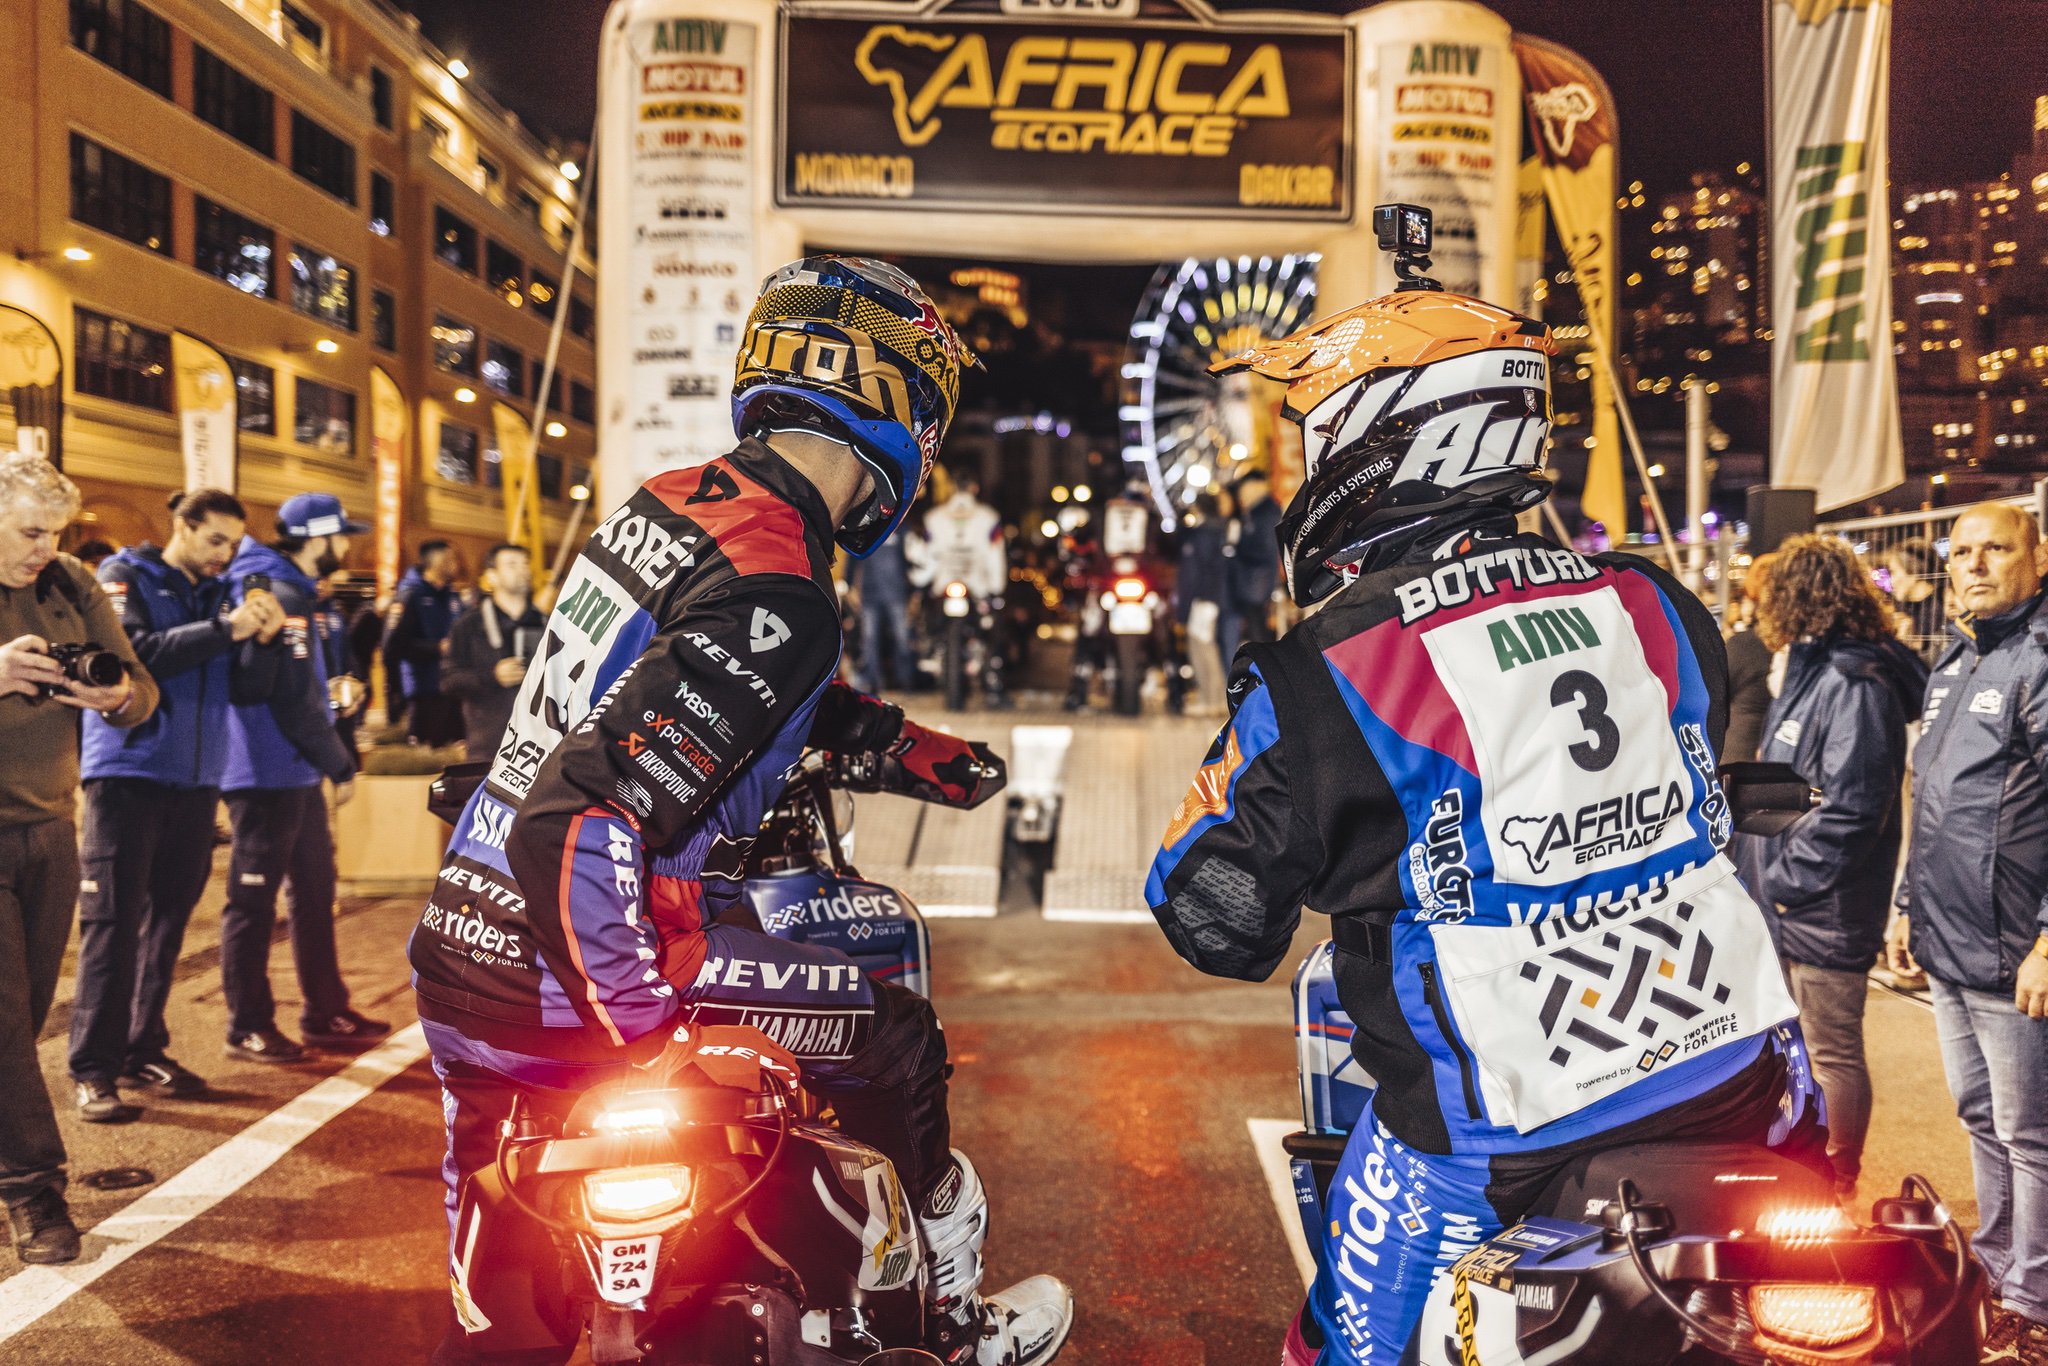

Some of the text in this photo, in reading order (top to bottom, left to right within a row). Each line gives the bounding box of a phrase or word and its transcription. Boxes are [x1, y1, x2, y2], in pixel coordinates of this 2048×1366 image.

[654, 20, 728, 54] AMV
[1408, 43, 1482, 76] AMV
[911, 35, 1290, 121] AFRICA
[795, 152, 914, 197] MONACO
[1239, 163, 1334, 206] DAKAR
[1501, 359, 1546, 381] BOTTU
[1301, 490, 1341, 536] COMPONENTS
[1339, 485, 1348, 497] &
[1346, 456, 1393, 491] SYSTEMS
[1395, 547, 1600, 625] BOTTURI
[1486, 606, 1601, 672] AMV
[577, 657, 645, 735] YAMAHA
[1549, 670, 1620, 772] 3
[672, 749, 708, 782] mobile ideas
[1535, 780, 1684, 863] AFRICA
[808, 886, 902, 923] riders
[444, 906, 522, 958] riders
[874, 926, 906, 936] FOR LIFE
[691, 956, 860, 992] REV'IT!
[752, 1015, 845, 1053] YAMAHA
[1683, 1013, 1737, 1042] TWO WHEELS
[1684, 1022, 1739, 1054] FOR LIFE
[1576, 1070, 1618, 1091] Powered
[609, 1260, 648, 1275] 724
[613, 1244, 646, 1257] GM
[612, 1278, 641, 1291] SA
[1390, 1252, 1409, 1295] Powered
[1515, 1284, 1555, 1311] YAMAHA
